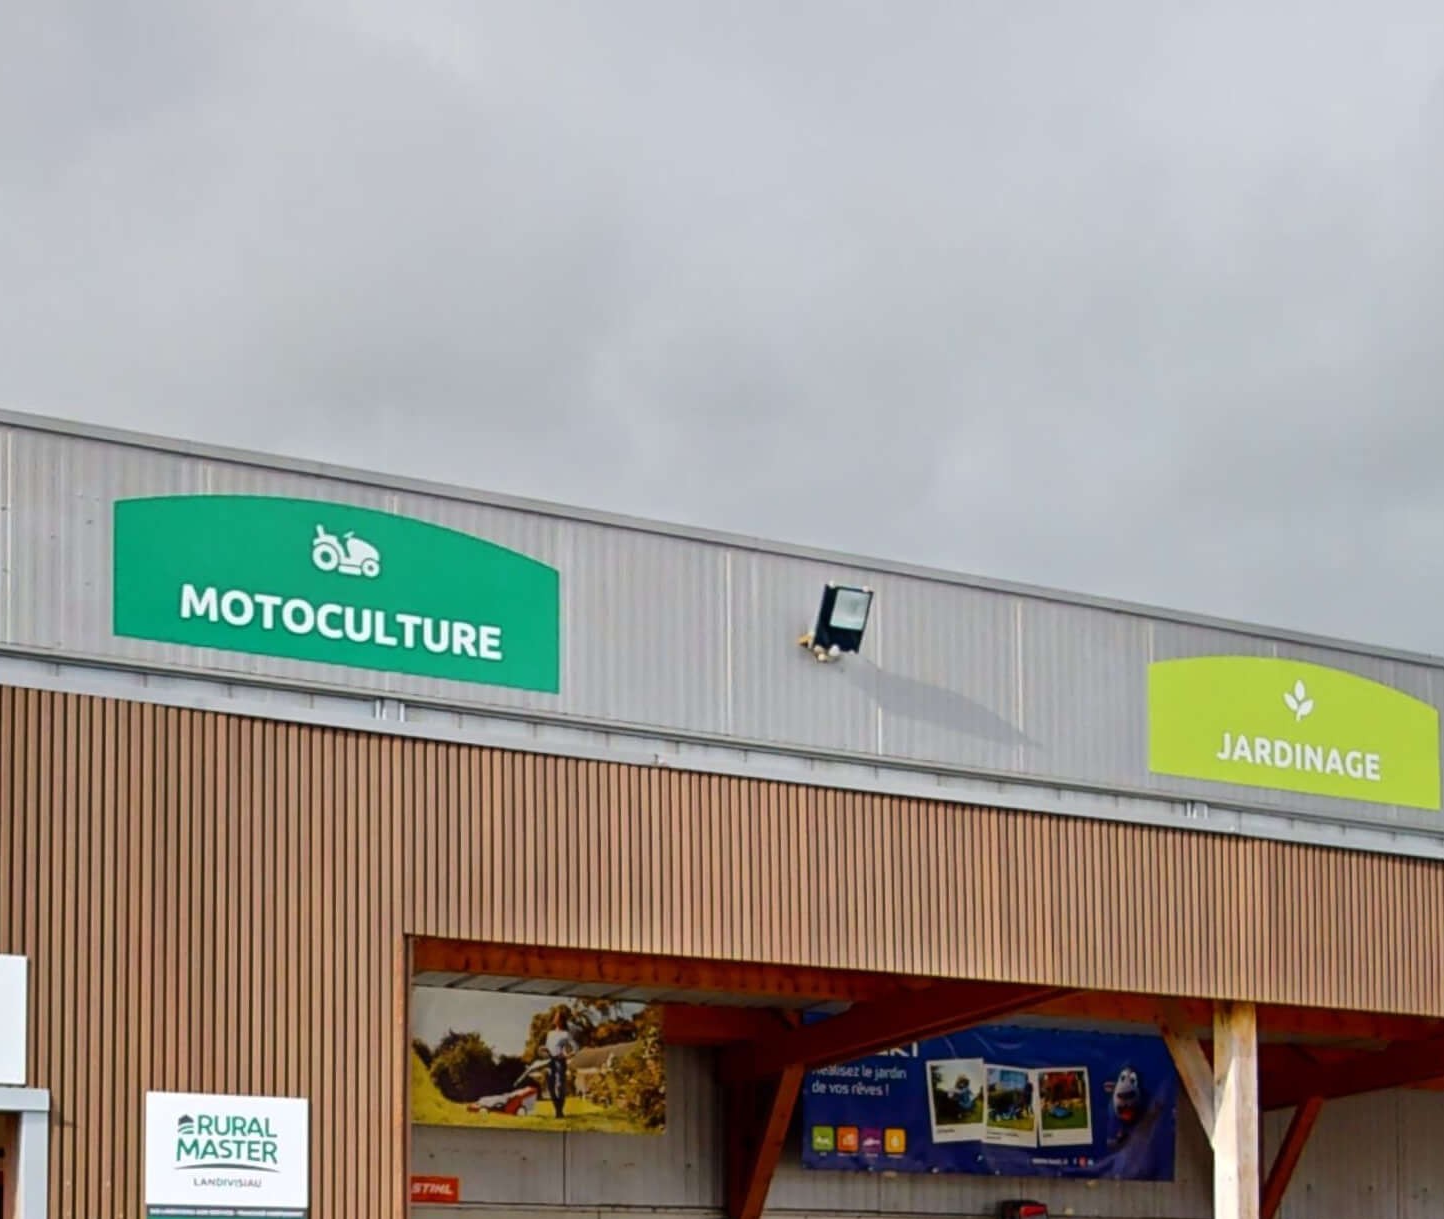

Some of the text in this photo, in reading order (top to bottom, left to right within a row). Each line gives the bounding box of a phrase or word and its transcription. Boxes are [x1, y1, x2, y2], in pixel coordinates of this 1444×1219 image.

[180, 584, 503, 660] MOTOCULTURE
[1216, 732, 1381, 780] JARDINAGE
[812, 1080, 826, 1093] de
[829, 1083, 849, 1094] vos
[197, 1114, 278, 1138] RURAL
[176, 1138, 278, 1164] MASTER
[193, 1177, 262, 1188] LANDIVISIAU
[411, 1182, 454, 1195] STIHL
